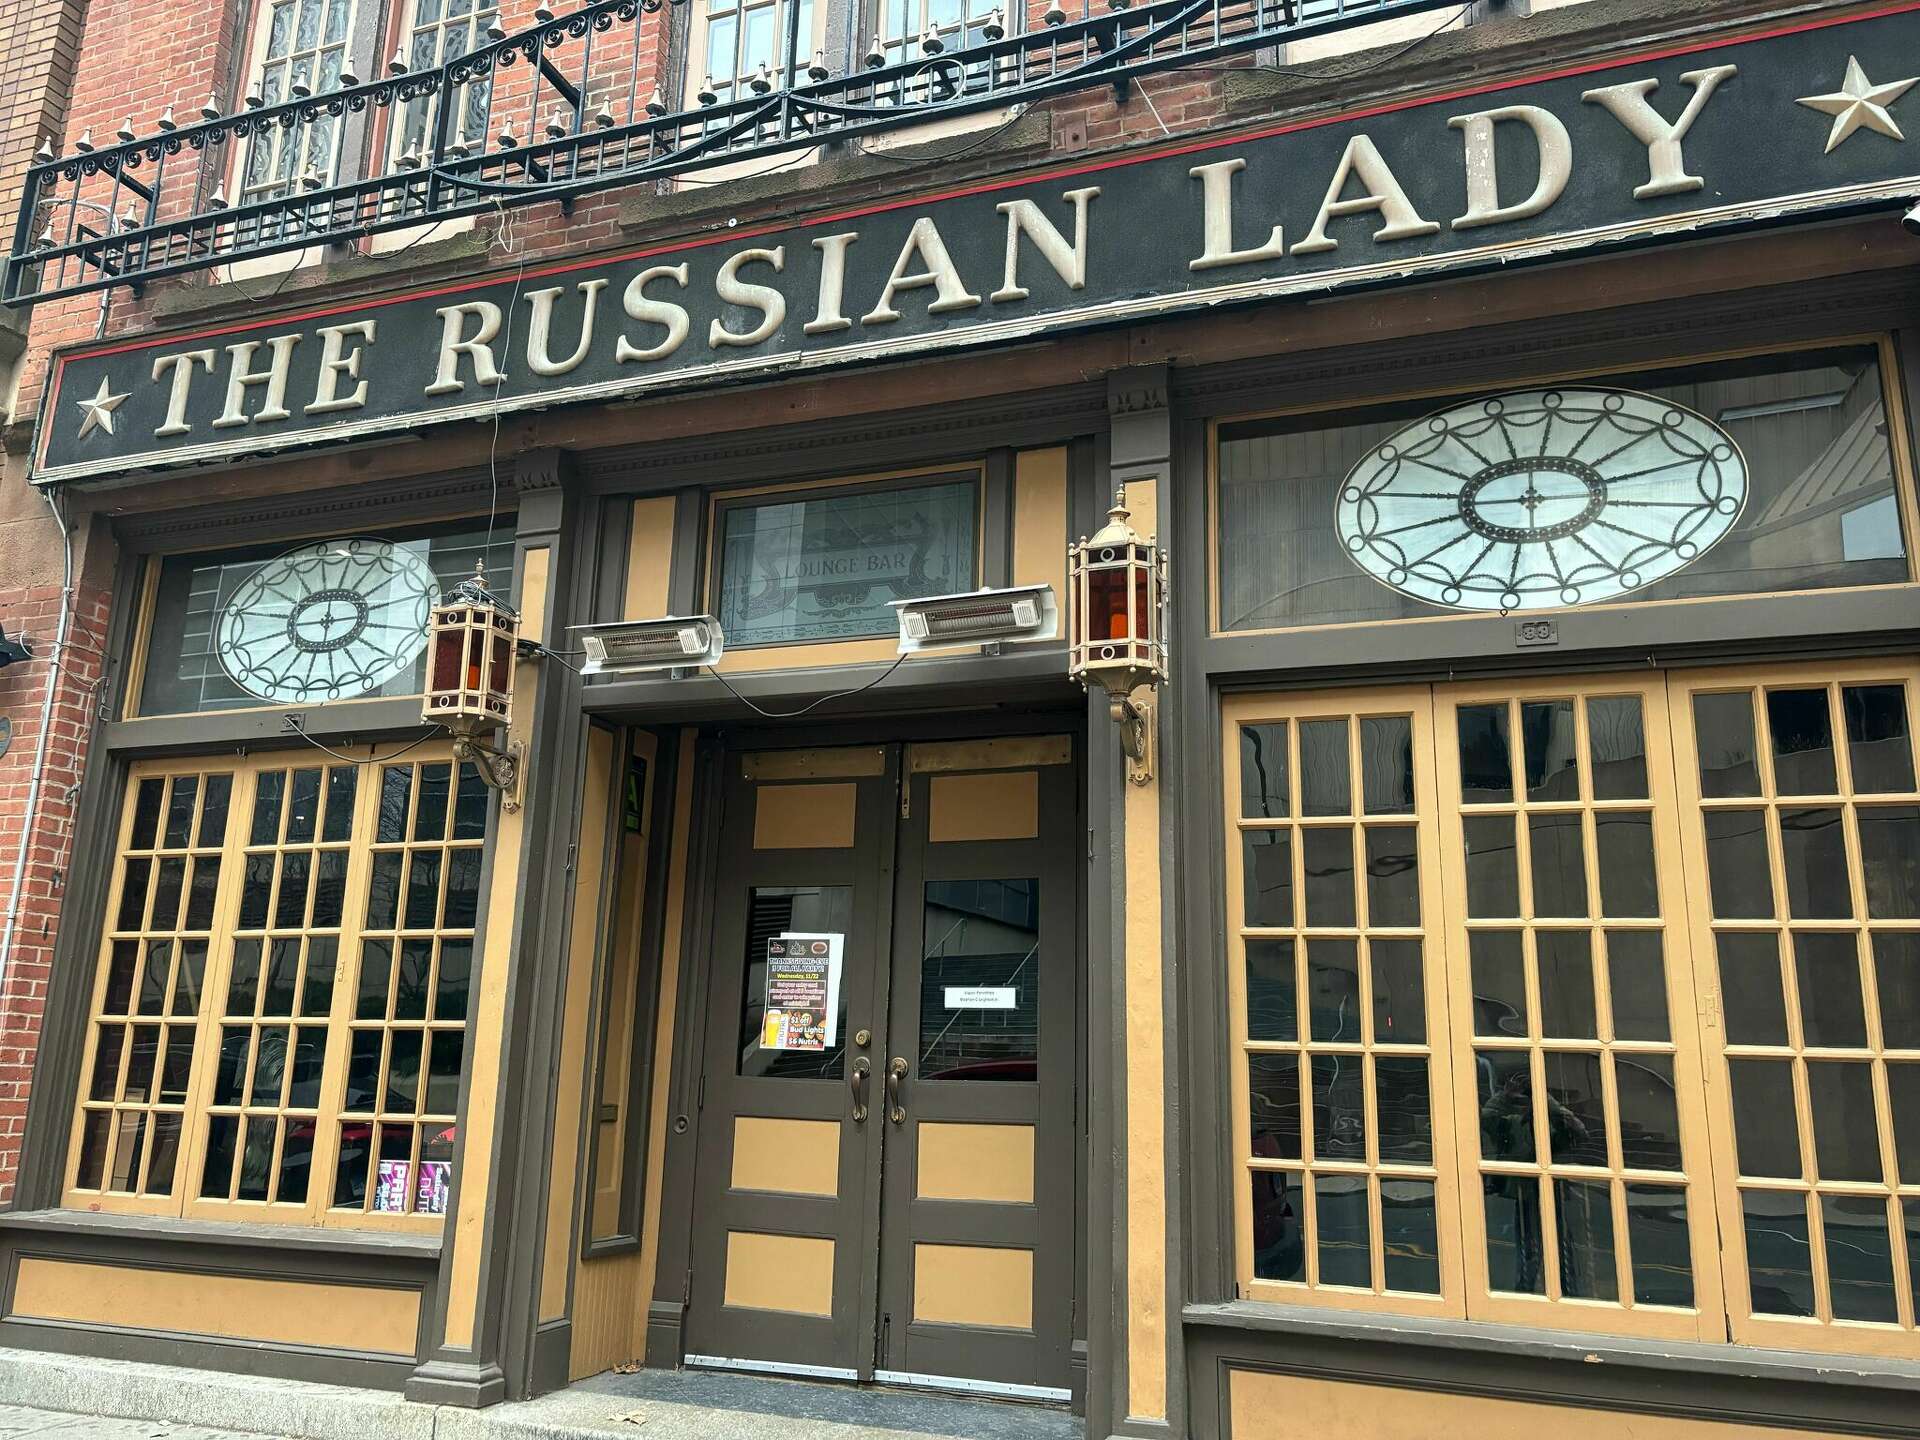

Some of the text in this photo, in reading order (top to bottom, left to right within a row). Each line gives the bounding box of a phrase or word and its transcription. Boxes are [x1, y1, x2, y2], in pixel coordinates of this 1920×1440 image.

[152, 64, 1738, 437] THE RUSSIAN LADY
[783, 552, 905, 578] LOUNGE BAR
[790, 1016, 810, 1024] $1 off
[804, 1026, 824, 1035] Lights
